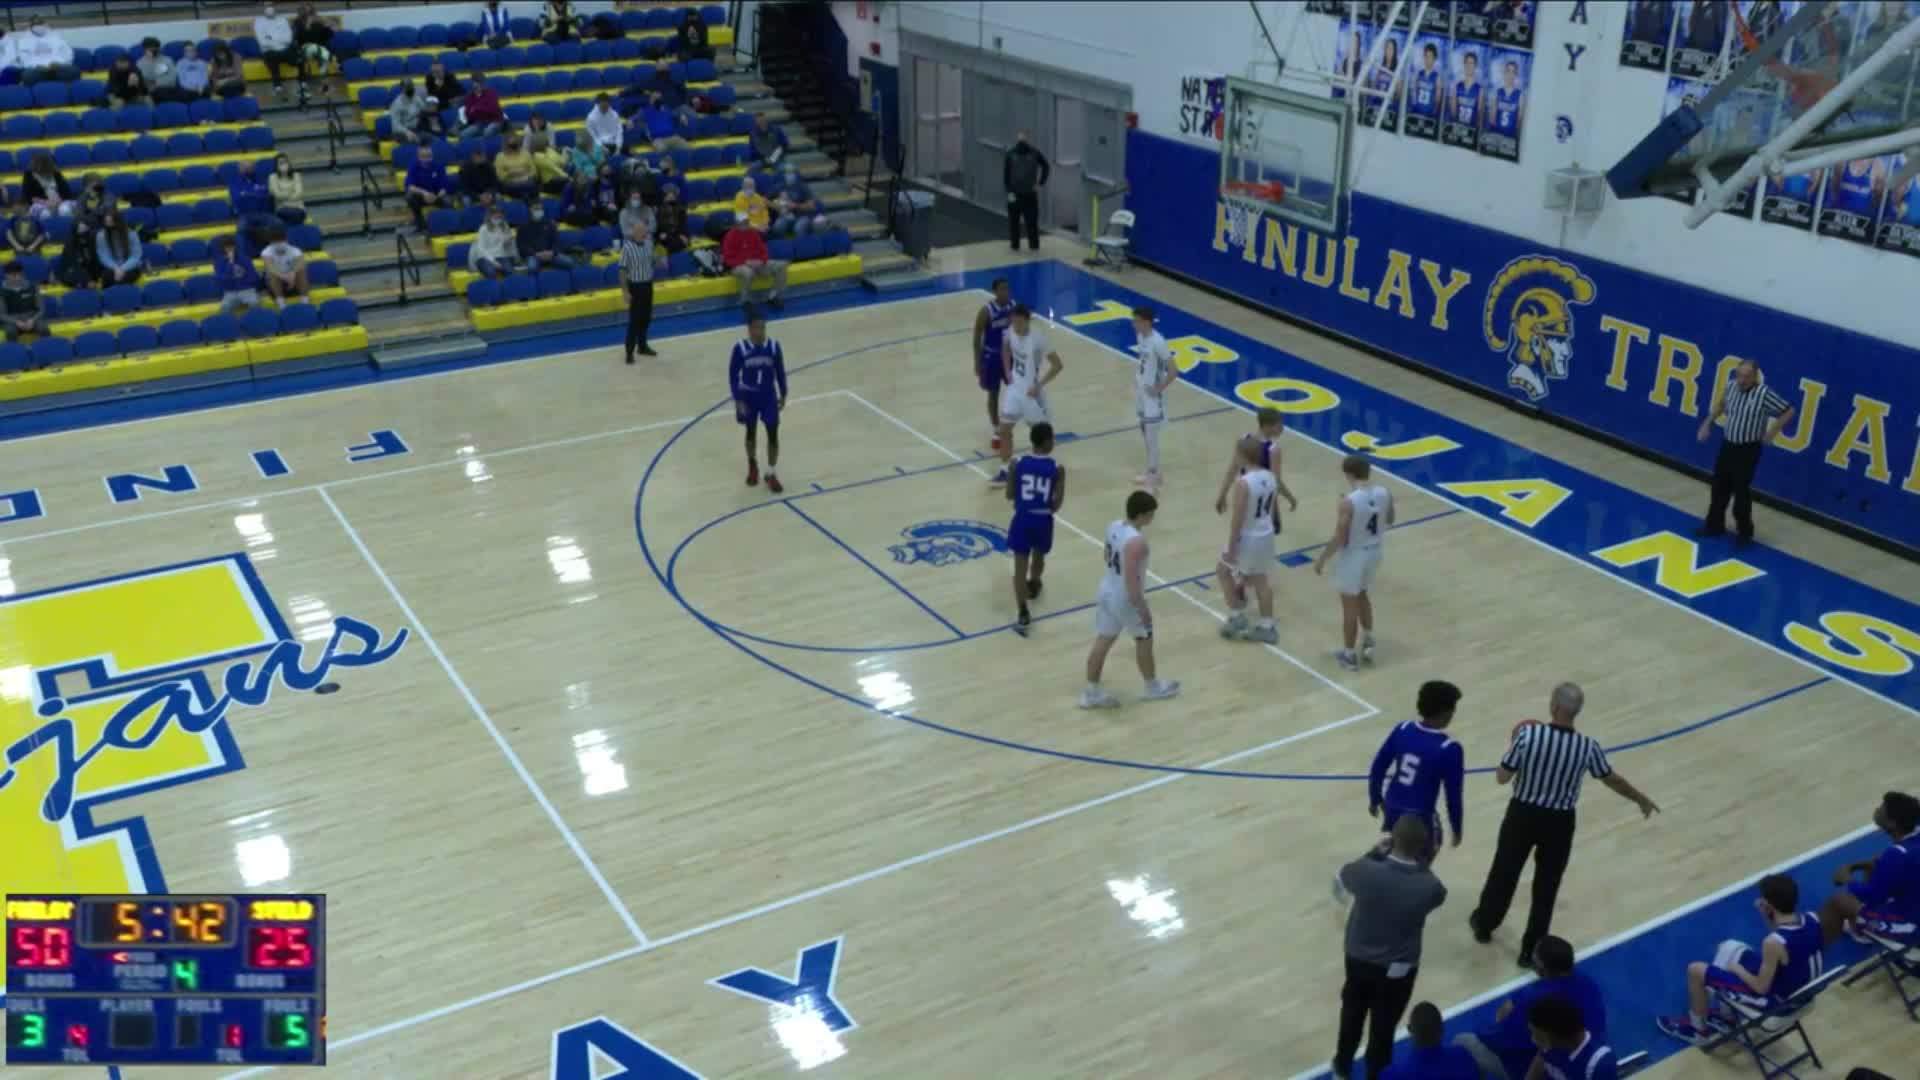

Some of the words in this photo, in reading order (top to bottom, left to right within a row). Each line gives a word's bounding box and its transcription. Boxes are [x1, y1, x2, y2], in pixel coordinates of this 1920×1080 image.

[1213, 202, 1471, 331] FINDLAY
[1021, 474, 1051, 502] 24
[1365, 512, 1378, 535] 4
[0, 615, 408, 823] jans
